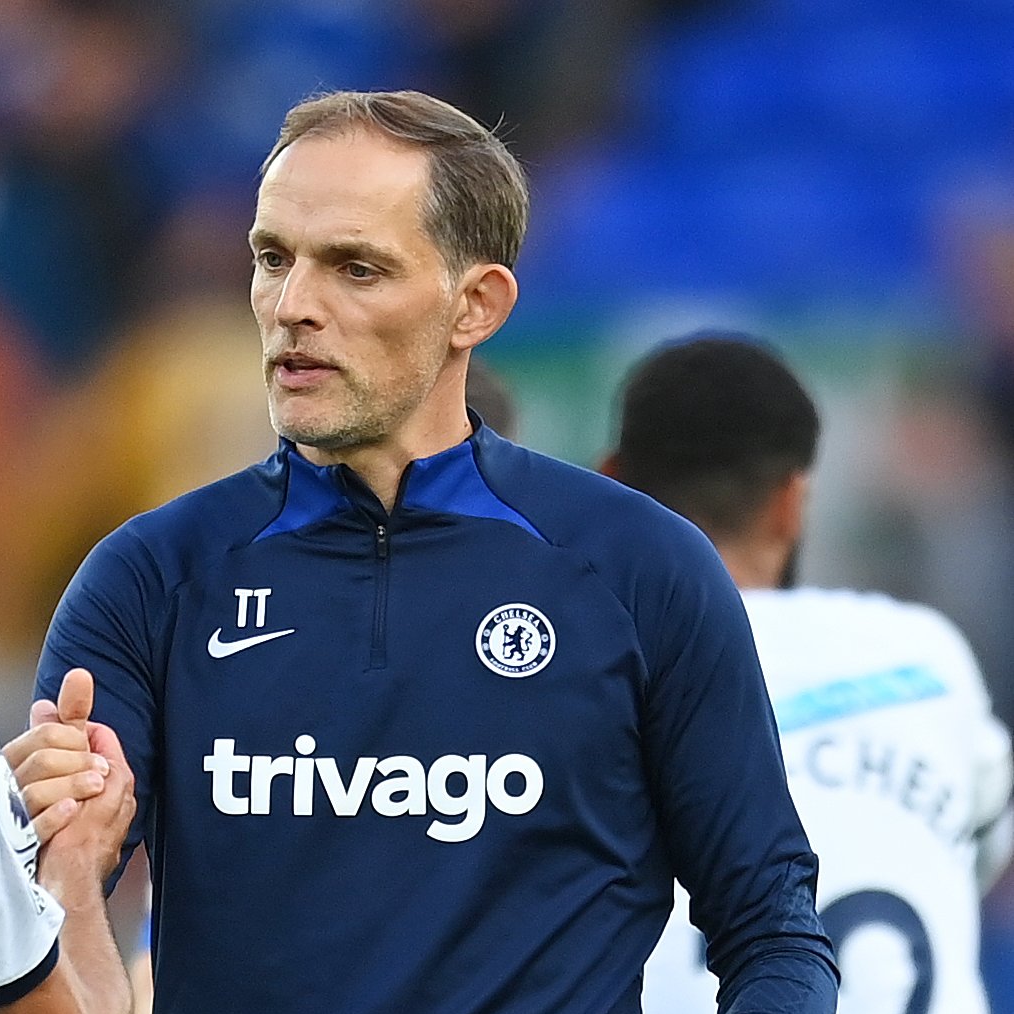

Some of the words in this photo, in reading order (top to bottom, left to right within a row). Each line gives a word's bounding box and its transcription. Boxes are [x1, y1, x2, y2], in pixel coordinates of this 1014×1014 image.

[234, 588, 272, 628] TT
[493, 609, 540, 628] CHELSEA
[203, 734, 544, 843] trivago
